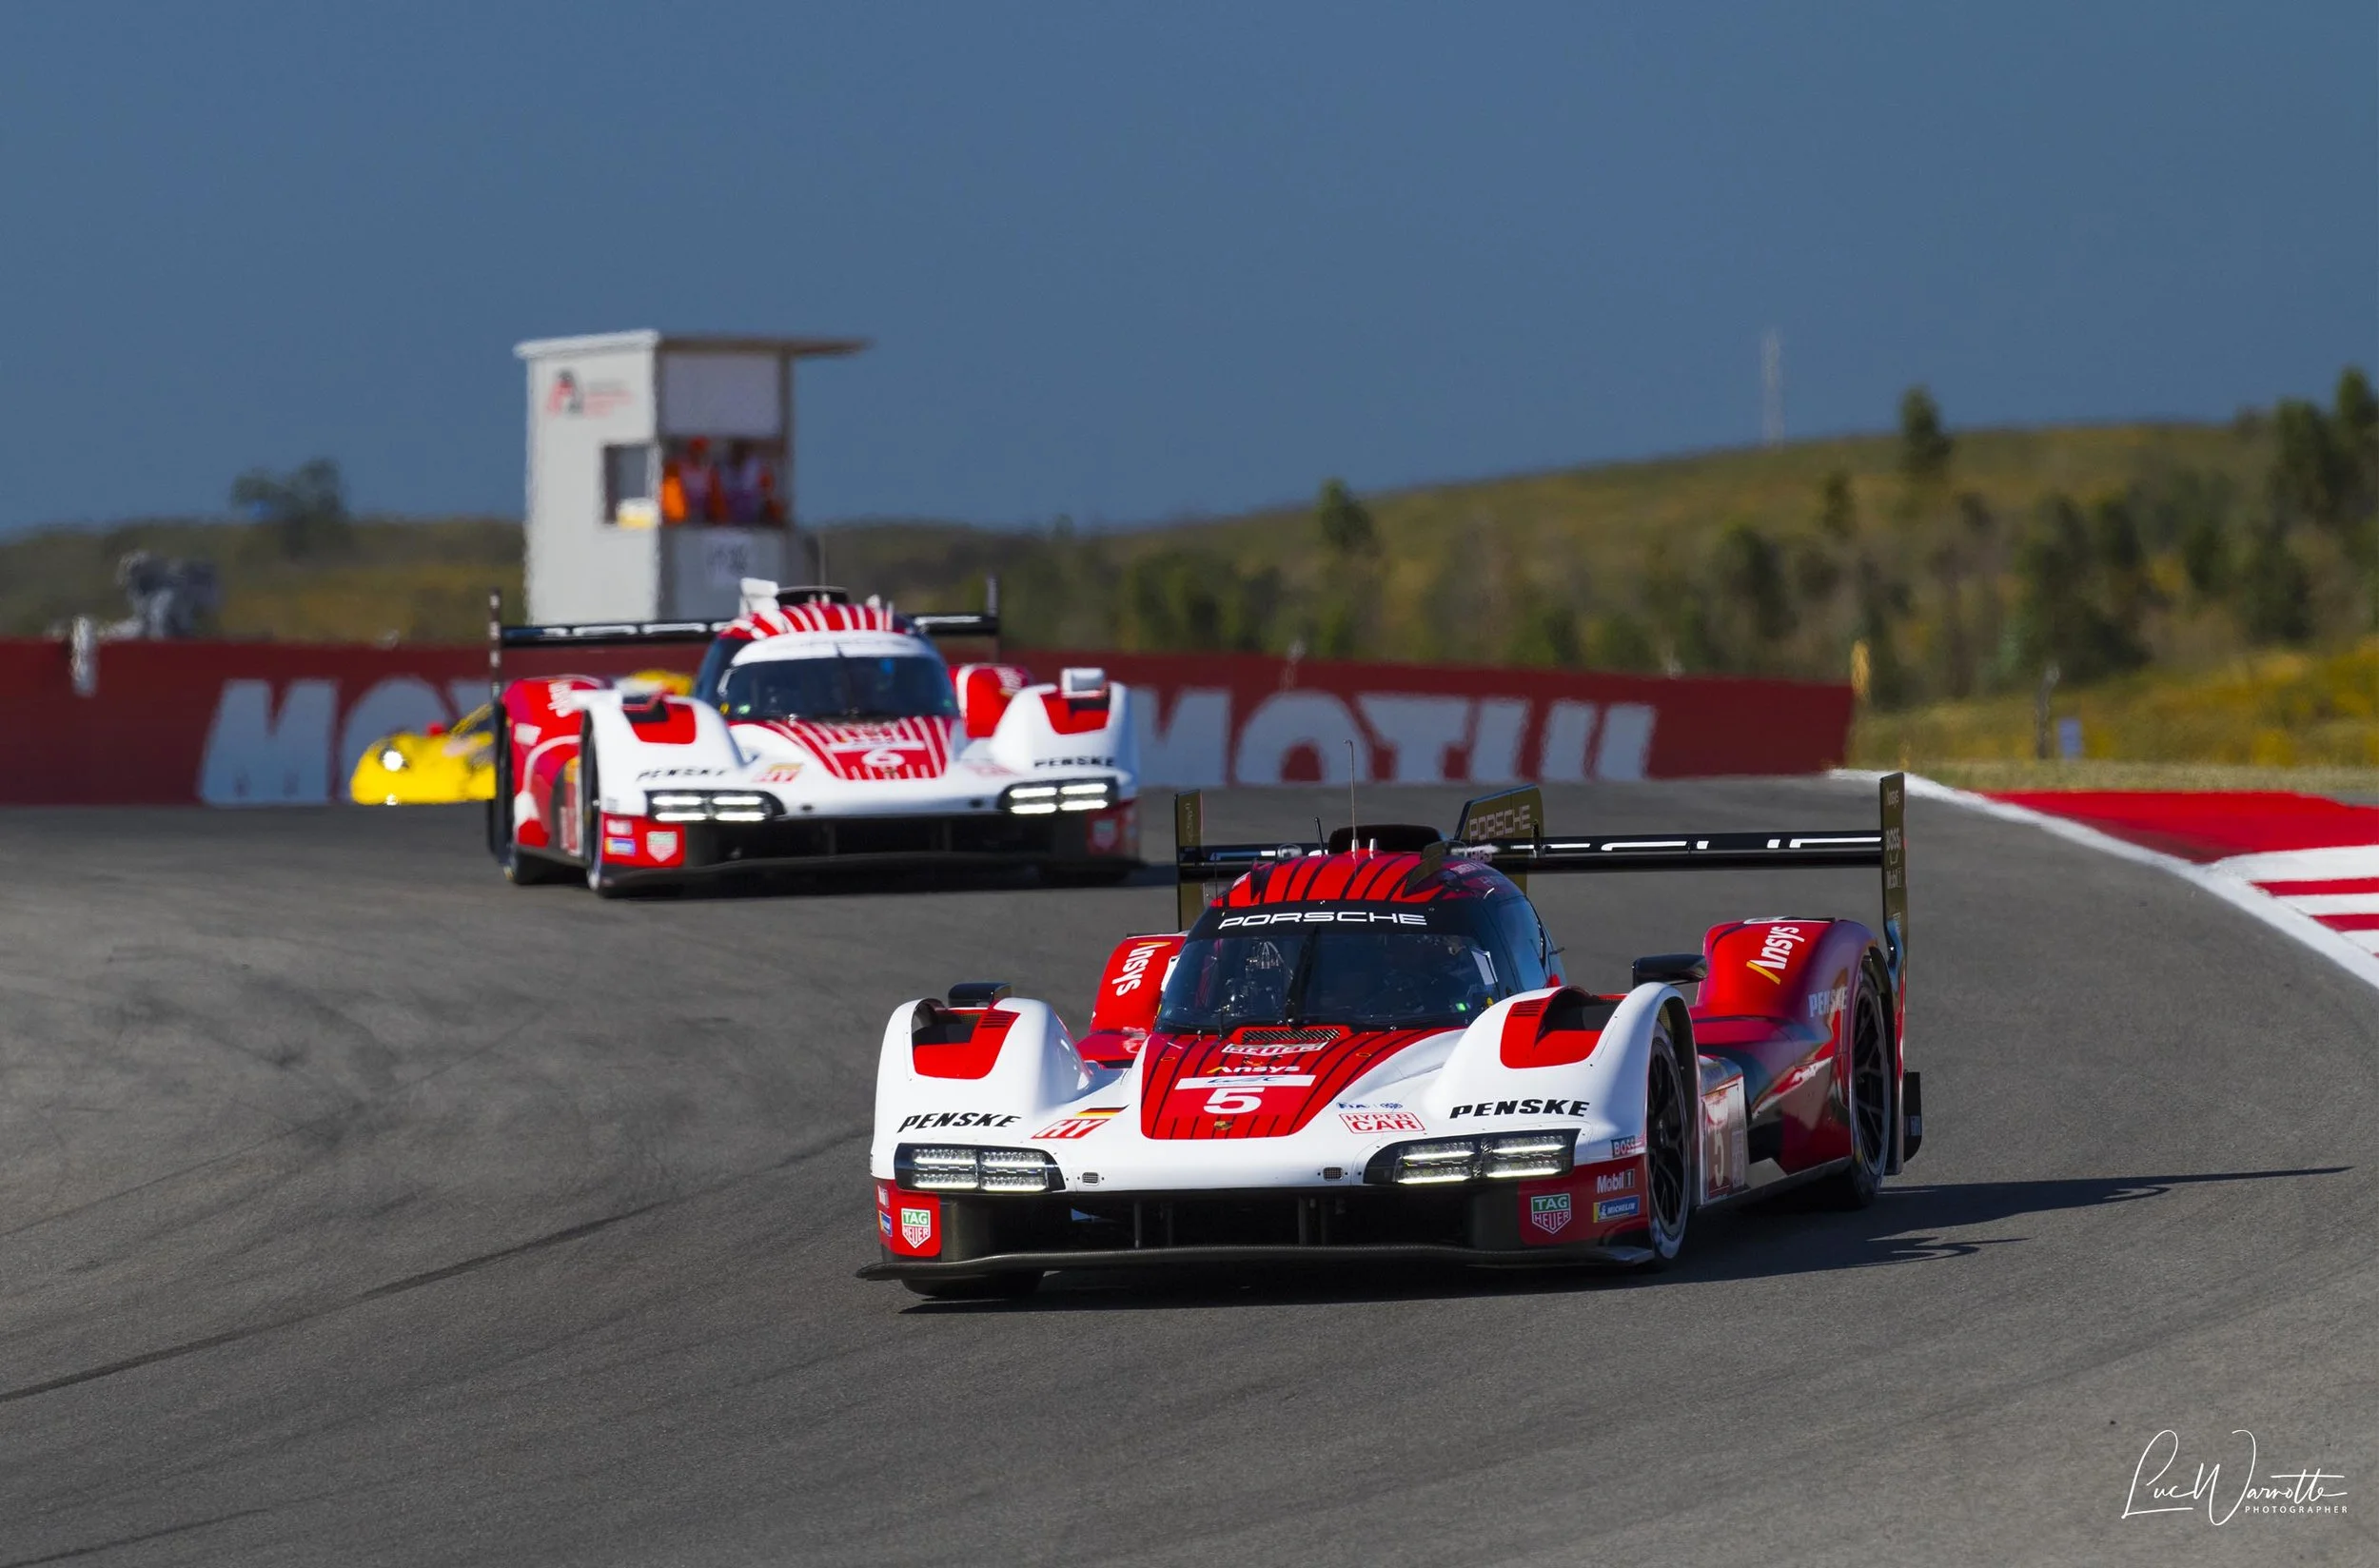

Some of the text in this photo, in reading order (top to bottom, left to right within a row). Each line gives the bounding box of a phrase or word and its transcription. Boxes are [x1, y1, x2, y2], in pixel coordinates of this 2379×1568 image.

[1469, 804, 1530, 843] PORSCHE
[1218, 911, 1427, 930] PORSCHE
[1745, 926, 1805, 986] Ansys
[1111, 941, 1172, 997] Ansys
[1809, 987, 1848, 1017] PENSKE
[1206, 1066, 1301, 1074] Ansys
[1203, 1087, 1266, 1114] 5
[1449, 1098, 1590, 1119] PENSKE
[897, 1111, 1022, 1133] PENSKE
[1351, 1120, 1418, 1131] CAR
[1597, 1171, 1624, 1194] Mobil
[1535, 1198, 1567, 1210] TAG
[1607, 1203, 1635, 1214] MICHELIN
[903, 1211, 929, 1225] TAG
[1534, 1211, 1569, 1231] HEUER
[903, 1226, 930, 1245] HEUER
